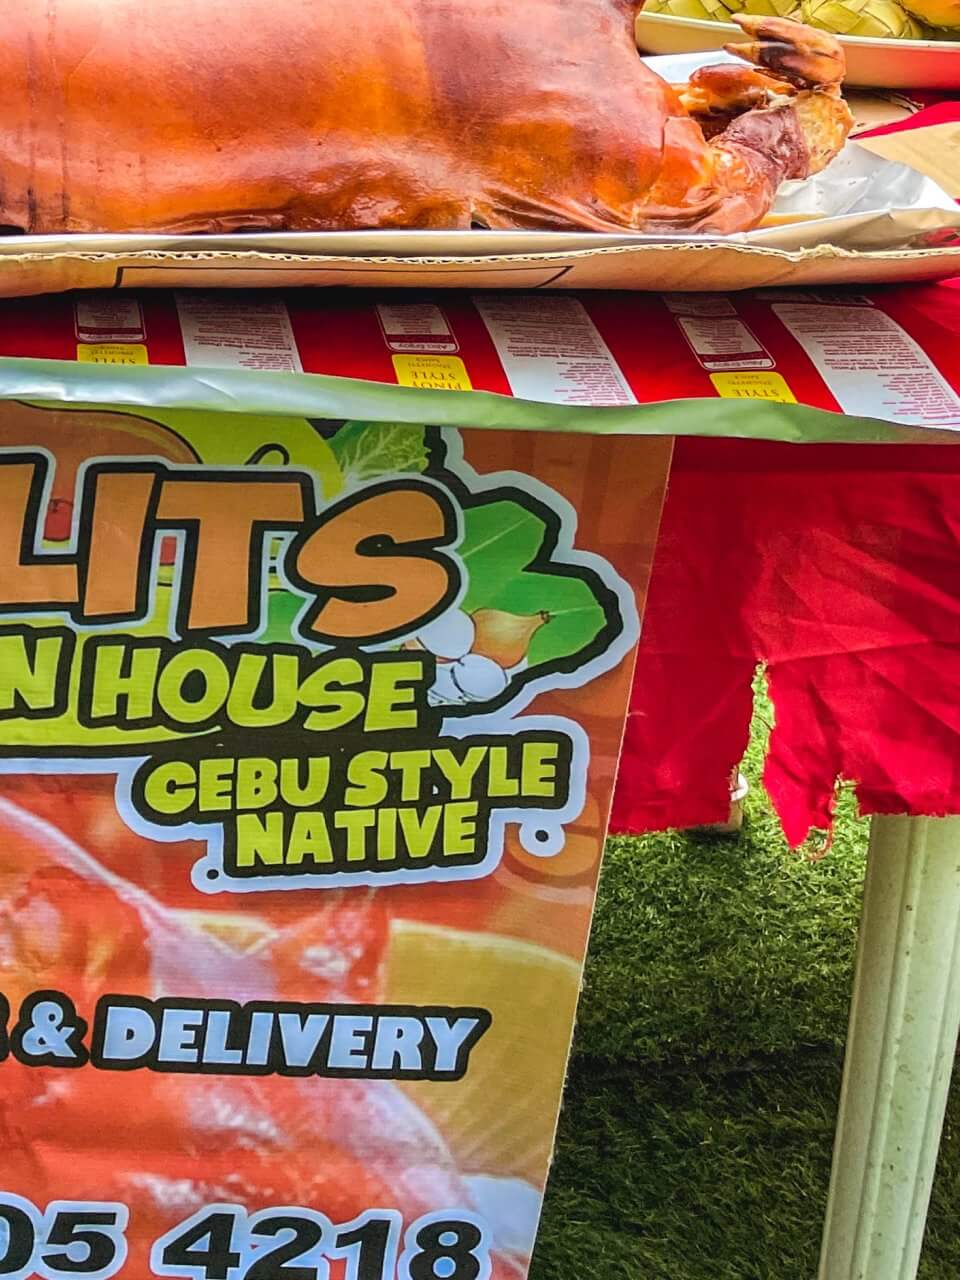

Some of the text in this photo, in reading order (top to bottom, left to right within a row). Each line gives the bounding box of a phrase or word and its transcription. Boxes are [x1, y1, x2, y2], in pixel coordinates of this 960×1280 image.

[731, 387, 777, 397] STYLE
[90, 646, 422, 732] HOUSE
[144, 742, 558, 814] CEBU STYLE
[236, 802, 479, 867] NATIVE
[22, 1001, 76, 1058] &
[102, 1006, 480, 1072] DELIVERY
[162, 1212, 482, 1280] 4218
